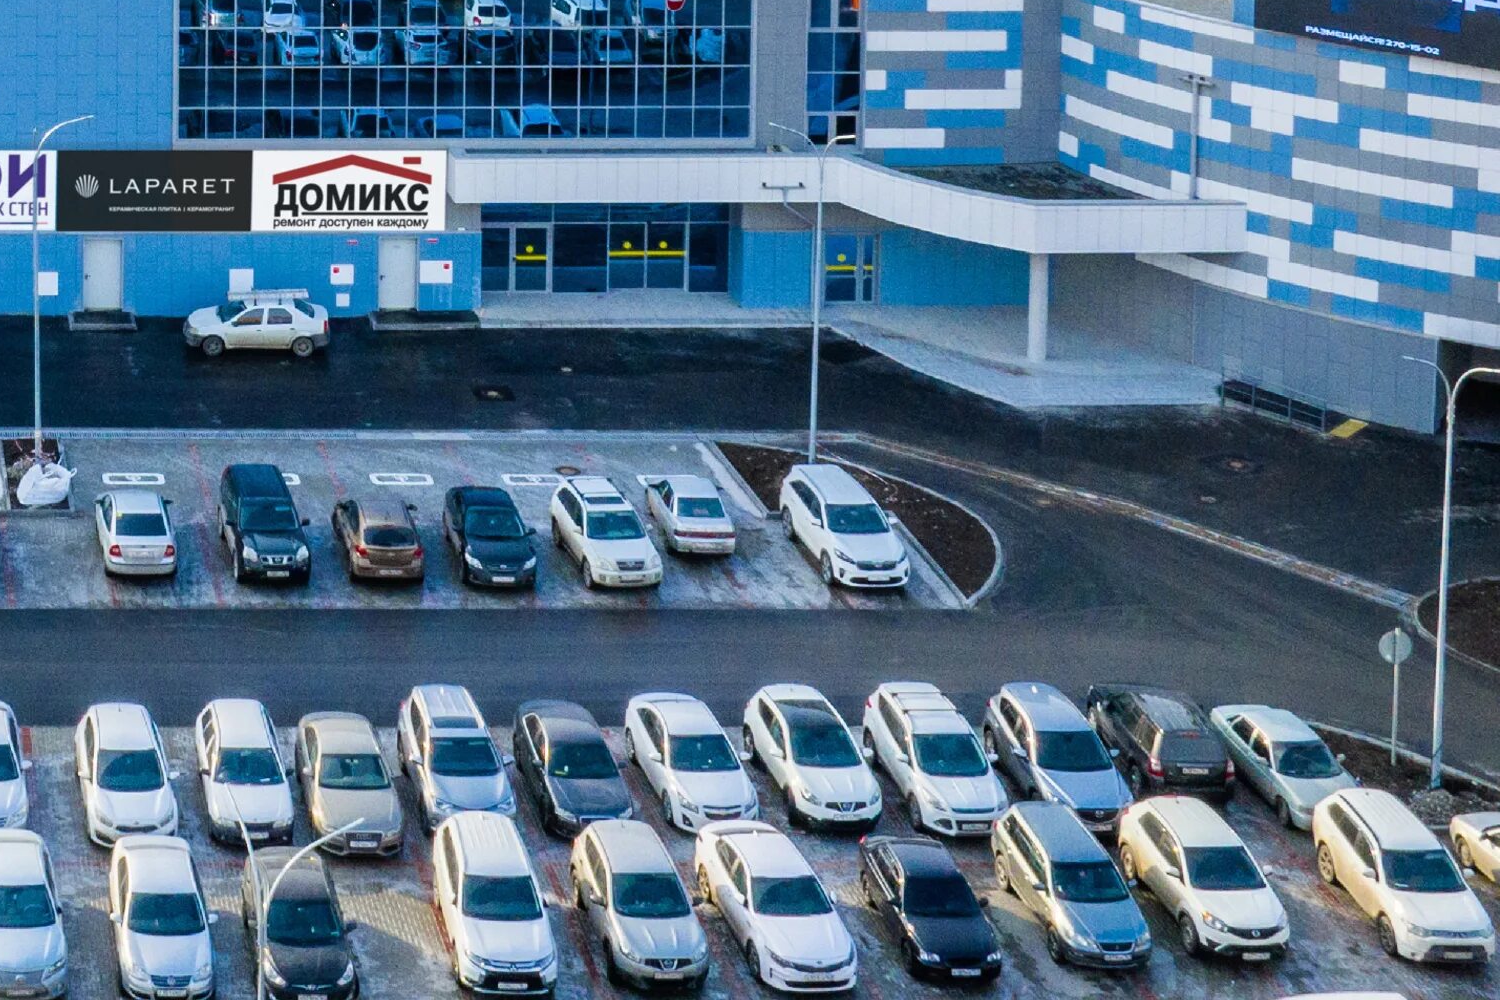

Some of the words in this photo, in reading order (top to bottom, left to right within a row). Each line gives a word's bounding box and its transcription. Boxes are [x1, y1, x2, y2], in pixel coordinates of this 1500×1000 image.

[1385, 39, 1440, 56] 270-15-02
[109, 178, 236, 194] LAPARET
[274, 183, 430, 217] ДОМИКС
[8, 202, 49, 217] СТЕН
[273, 218, 316, 230] ремонт
[318, 218, 374, 230] доступен
[377, 218, 430, 230] каждому
